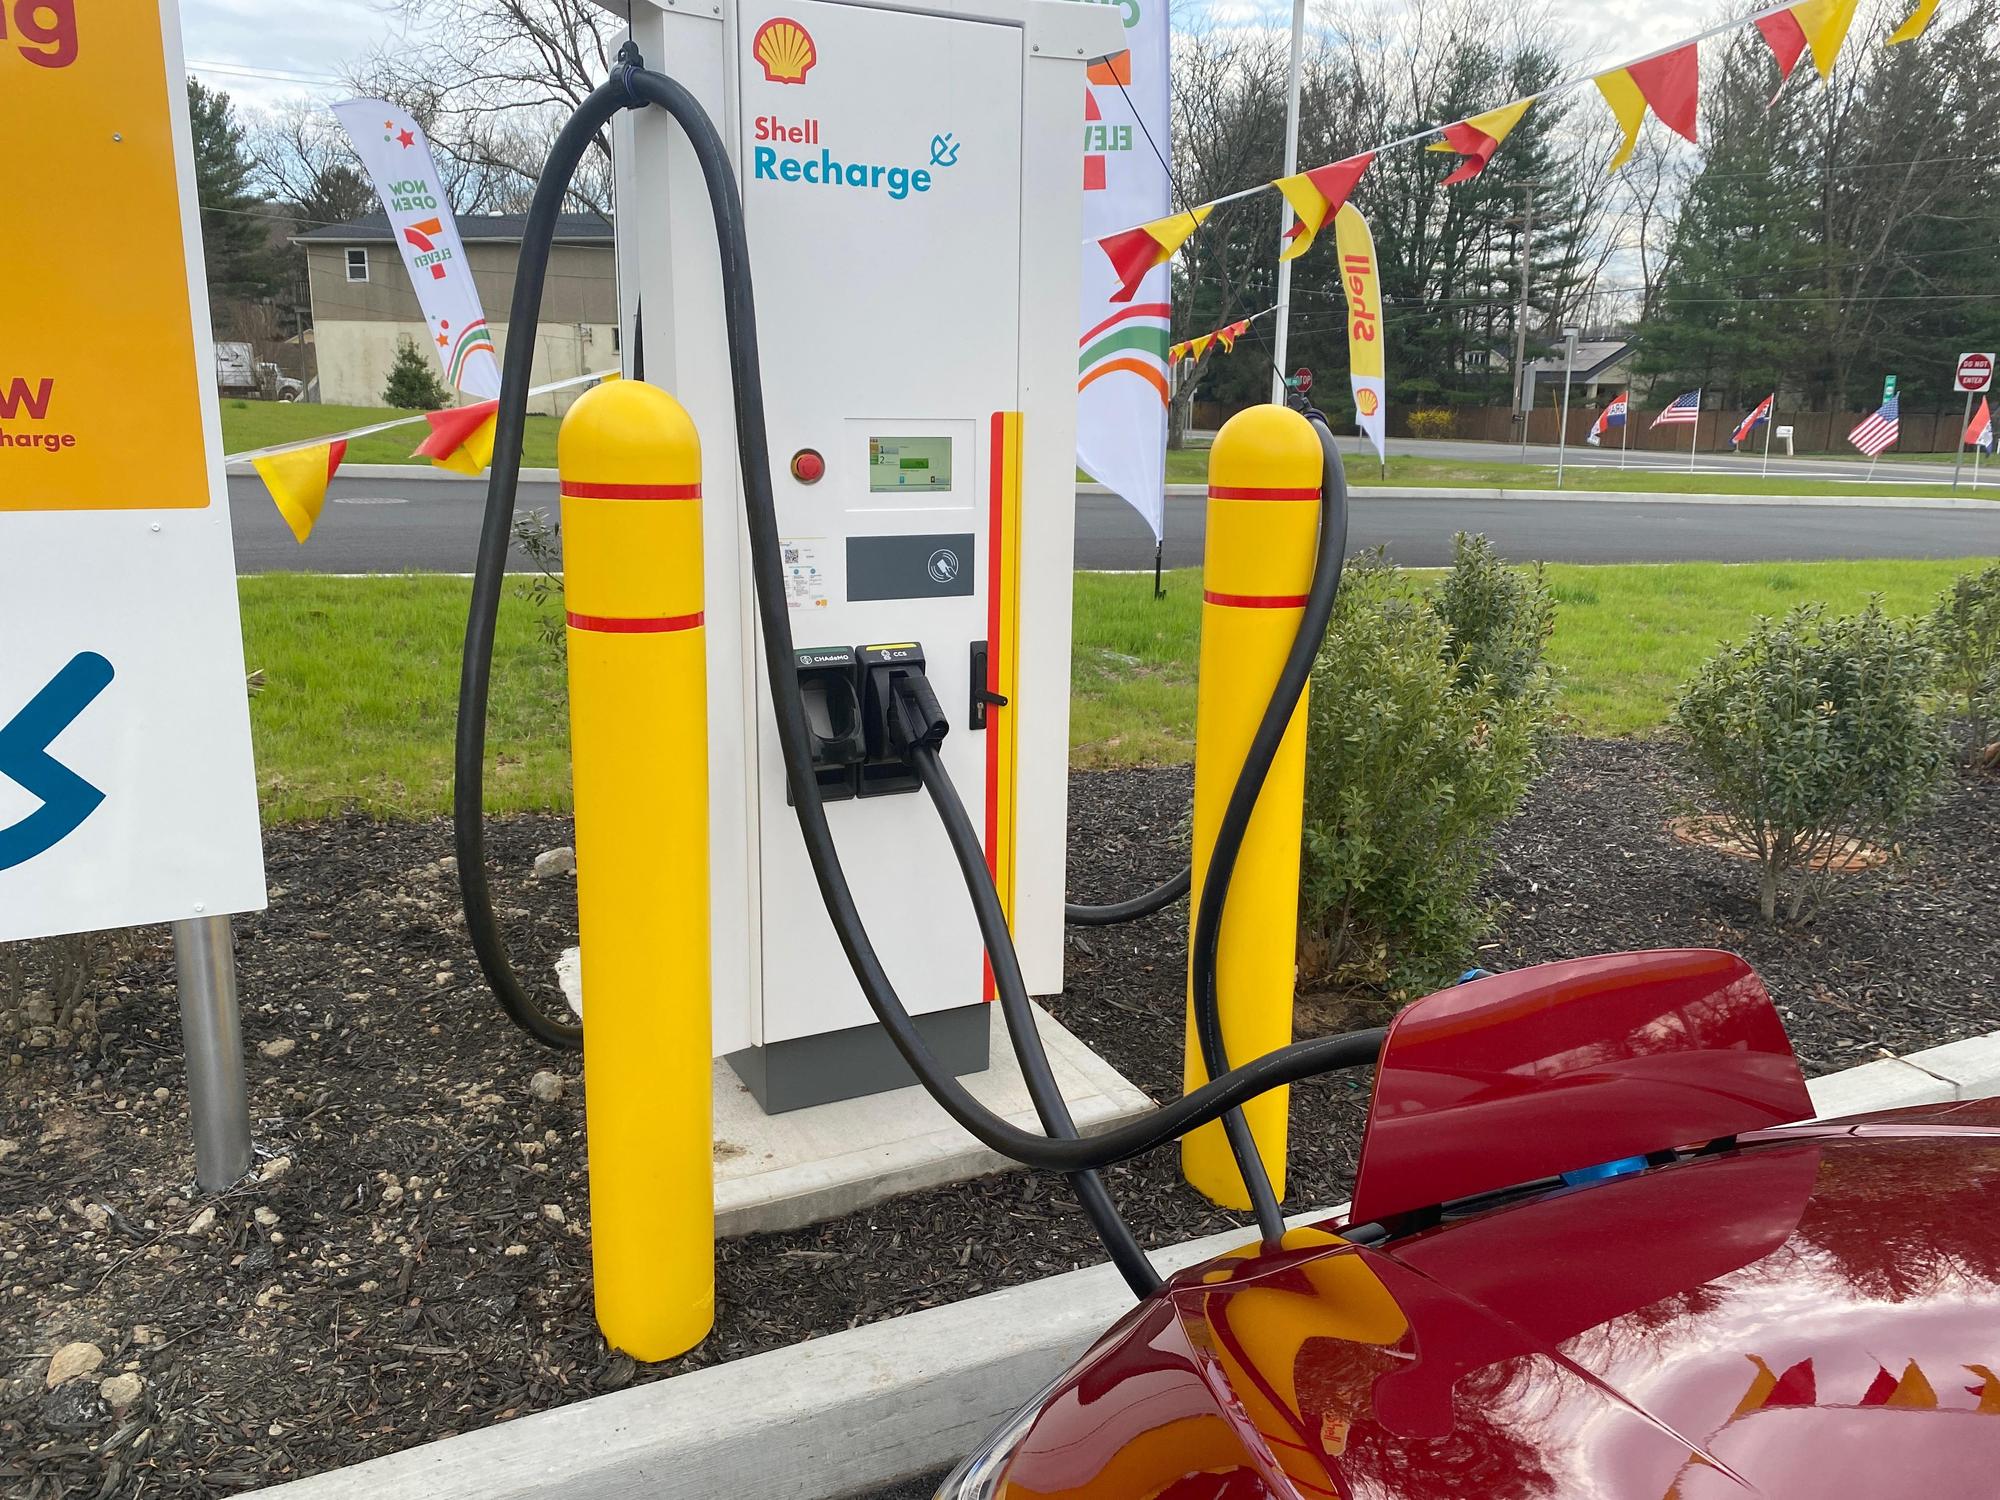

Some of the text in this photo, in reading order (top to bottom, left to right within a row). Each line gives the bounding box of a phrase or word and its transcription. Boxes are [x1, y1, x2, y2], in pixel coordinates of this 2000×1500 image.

[755, 116, 818, 144] Shell
[755, 146, 931, 200] Recharge
[1962, 376, 1983, 384] ENTER
